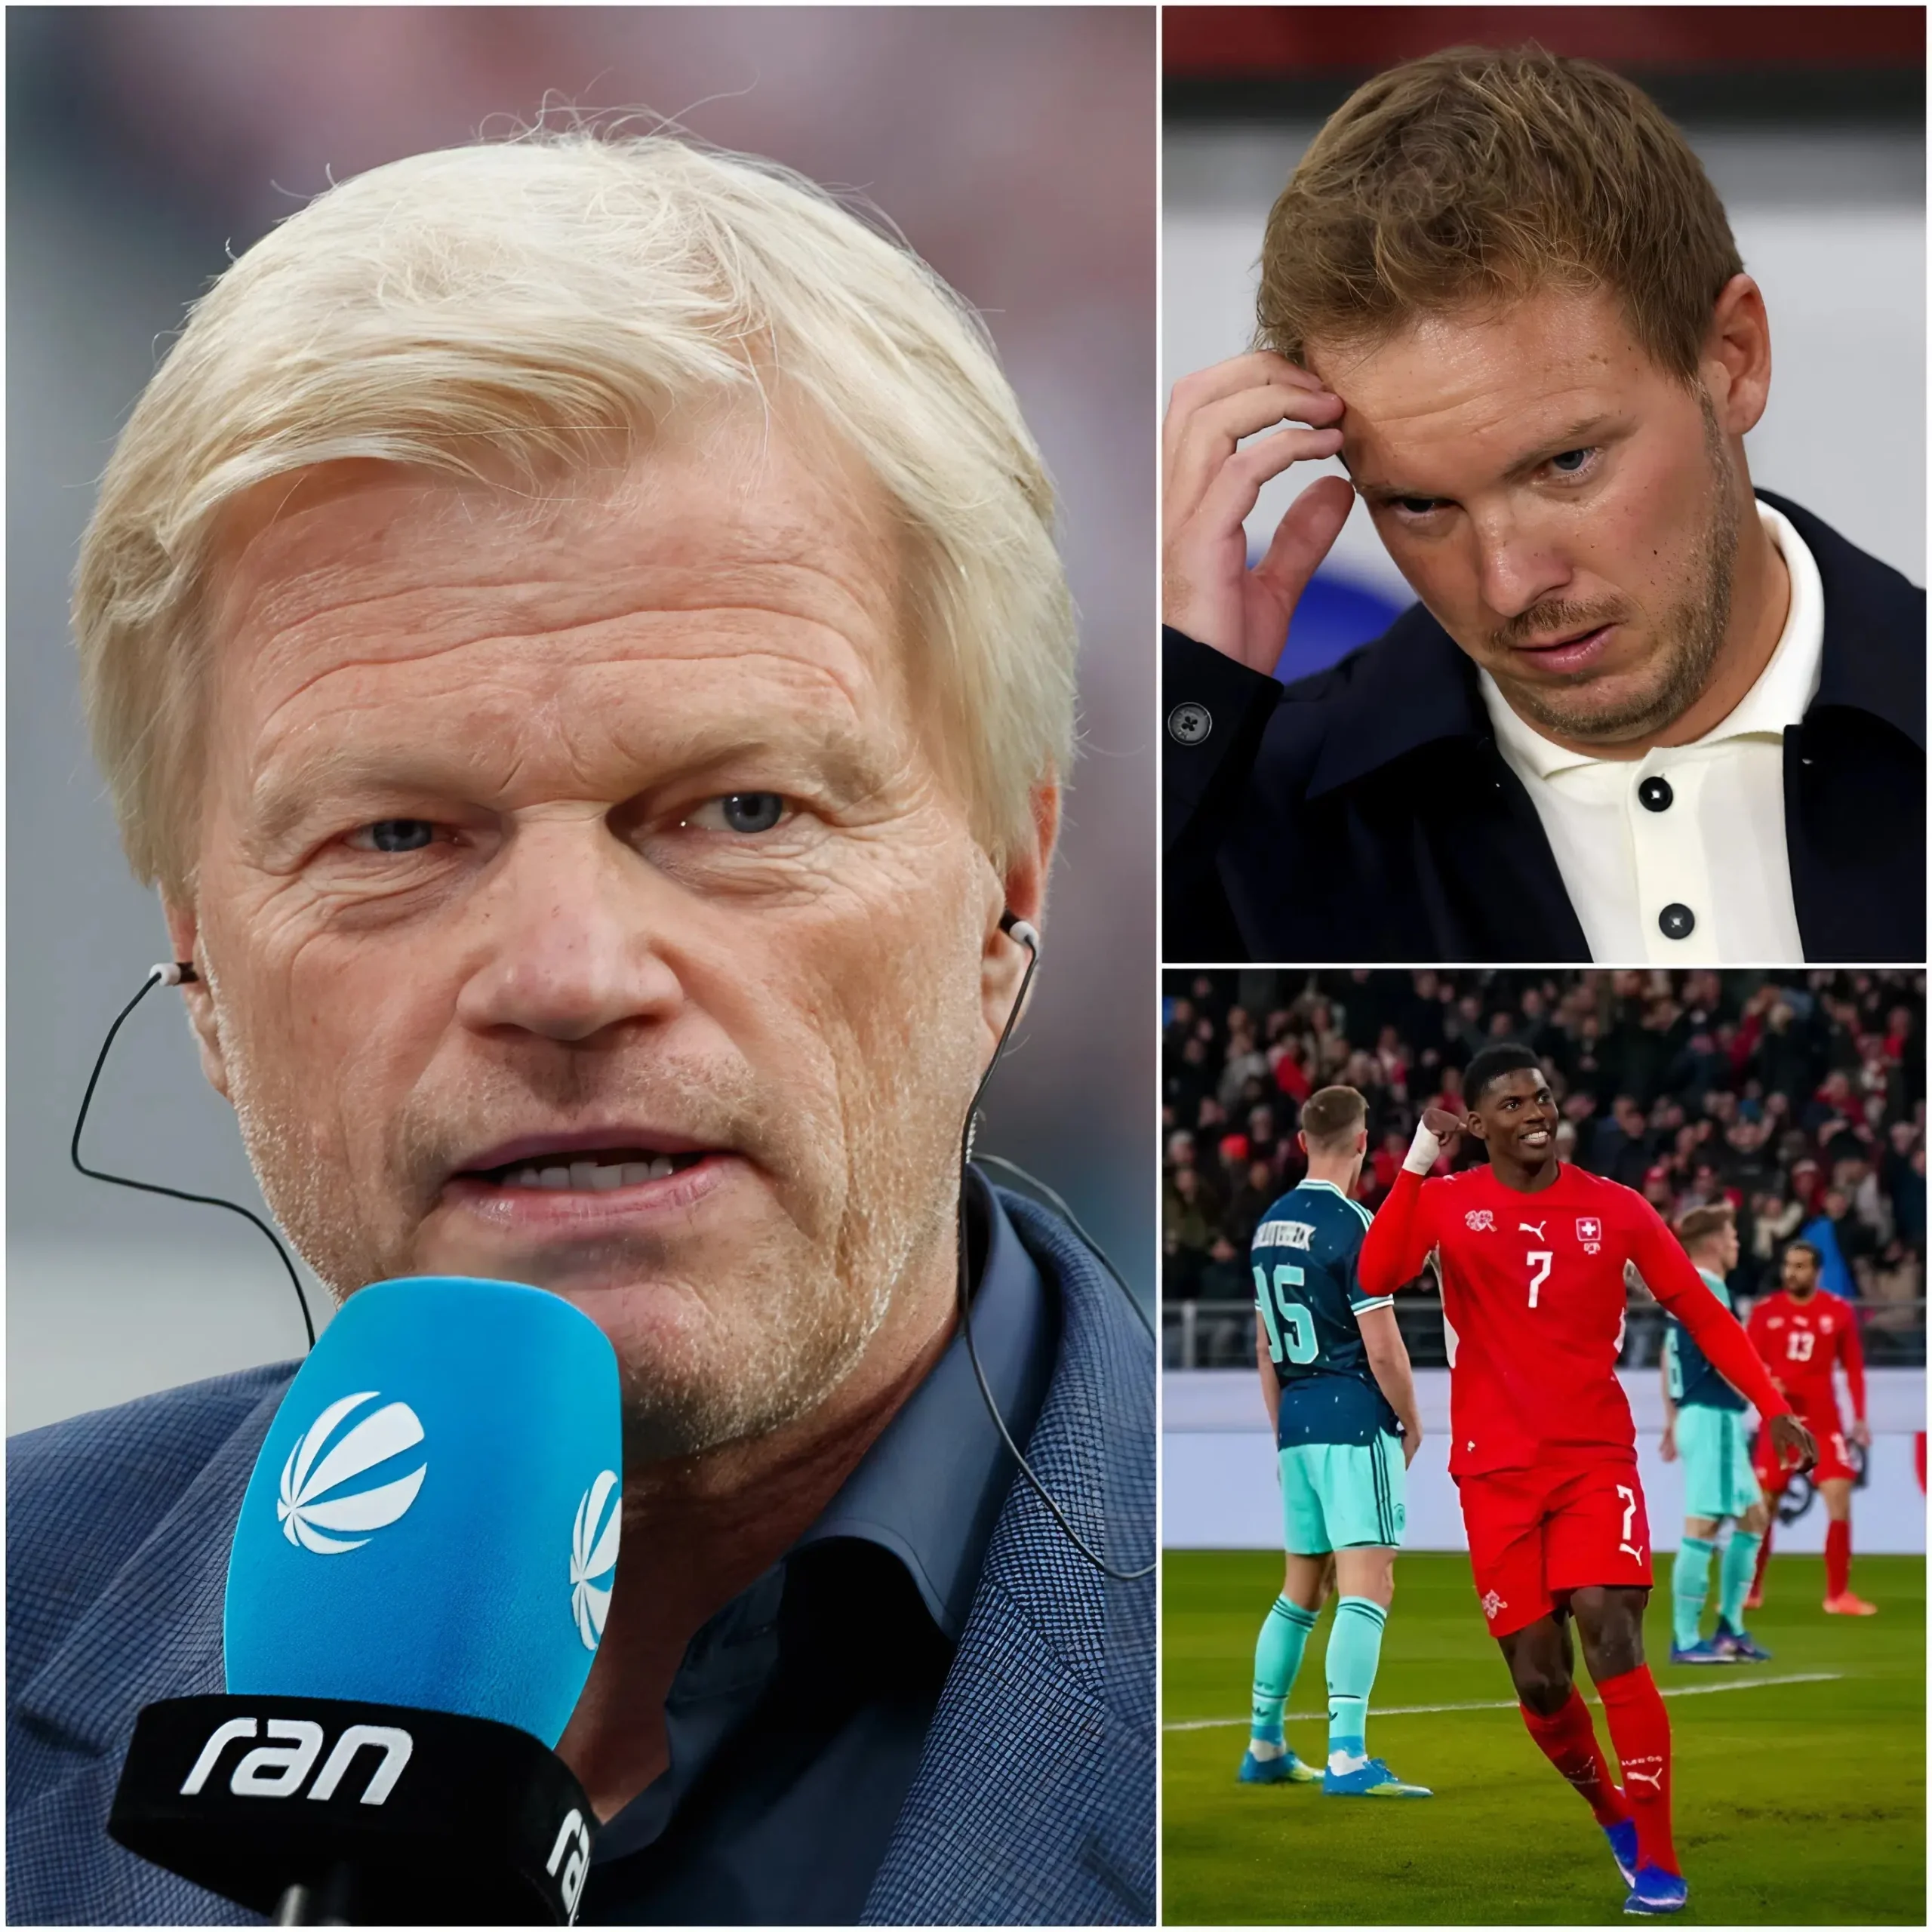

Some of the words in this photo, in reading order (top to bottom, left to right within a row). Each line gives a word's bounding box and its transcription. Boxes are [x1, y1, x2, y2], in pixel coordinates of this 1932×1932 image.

[1252, 1264, 1319, 1364] 15
[1527, 1251, 1553, 1308] 7
[1787, 1332, 1815, 1361] 13
[1616, 1484, 1636, 1540] 7
[180, 1717, 413, 1805] ran
[546, 1808, 591, 1927] ra
